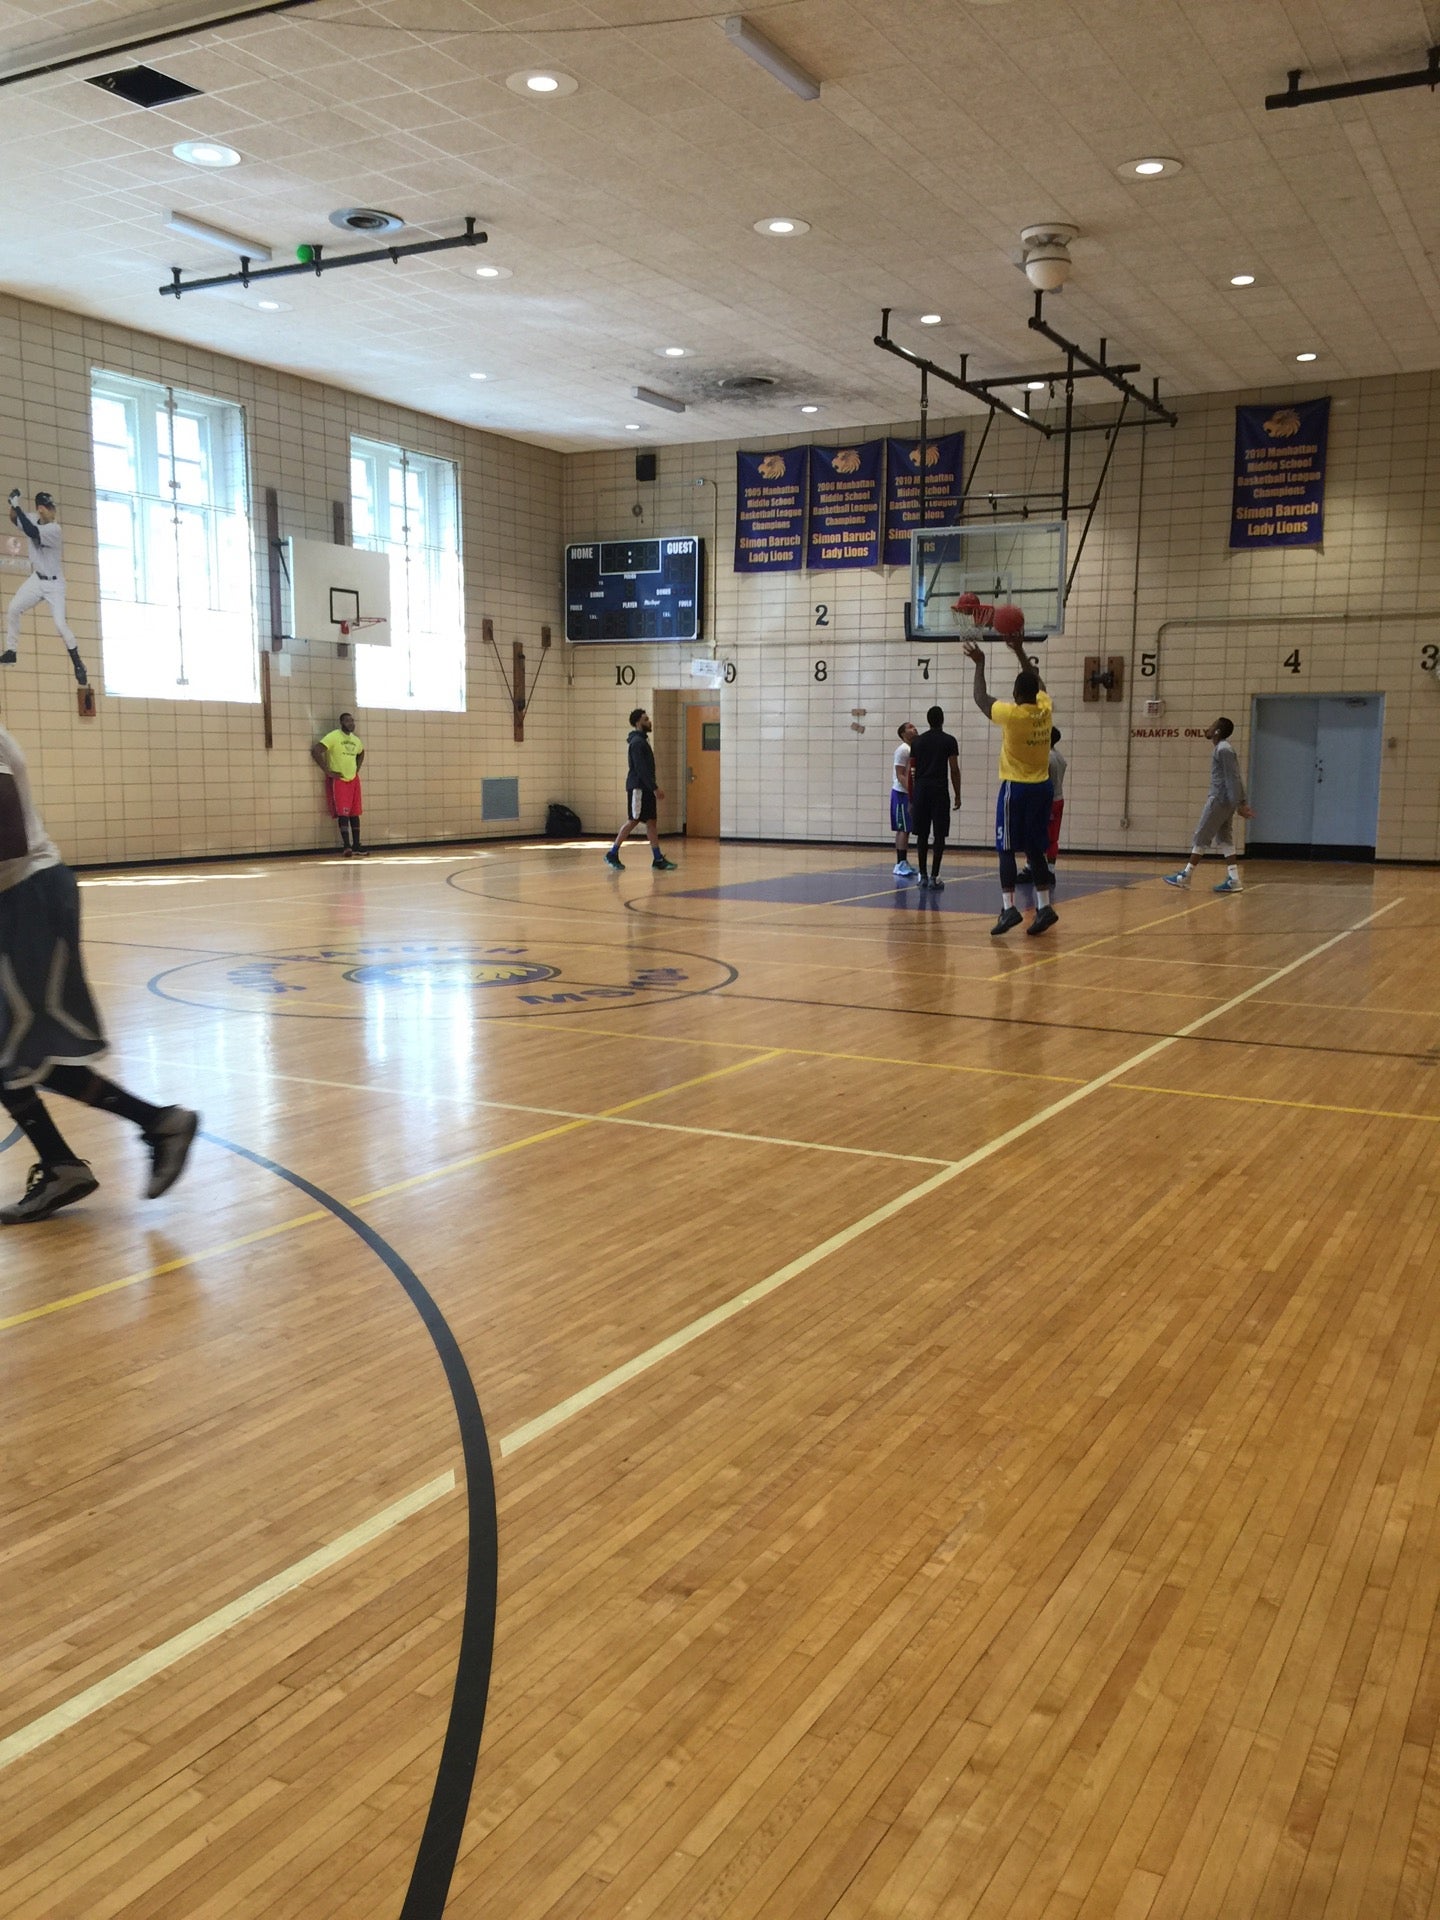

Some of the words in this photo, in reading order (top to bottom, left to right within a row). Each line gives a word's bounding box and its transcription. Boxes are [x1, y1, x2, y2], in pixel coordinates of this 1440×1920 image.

[1267, 445, 1317, 457] Manhattan
[1247, 461, 1278, 473] Middle
[1280, 457, 1312, 470] School
[836, 480, 875, 490] Manhattan
[913, 473, 955, 485] Mnhattan
[1237, 472, 1285, 487] Basketball
[1287, 471, 1321, 483] League
[763, 485, 799, 496] Manhattan
[820, 493, 843, 503] Middle
[844, 490, 870, 501] School
[1253, 485, 1306, 498] Champions
[747, 499, 770, 508] Middle
[771, 496, 795, 507] School
[812, 504, 849, 516] Basketball
[851, 502, 878, 513] League
[740, 509, 776, 520] Basketball
[777, 508, 802, 518] League
[1236, 506, 1273, 520] Simon
[1275, 501, 1319, 517] Baruch
[752, 520, 791, 531] Champions
[825, 515, 866, 526] Champions
[888, 528, 913, 540] Simo
[1247, 522, 1275, 537] Lady
[1276, 520, 1308, 534] Lions
[740, 537, 767, 549] Simon
[768, 534, 801, 548] Baruch
[812, 533, 841, 545] Simon
[842, 529, 876, 543] Baruch
[571, 548, 593, 560] HOME
[667, 541, 694, 555] GUEST
[749, 551, 769, 563] Lady
[770, 550, 794, 562] Lions
[821, 547, 842, 560] Lady
[843, 546, 869, 558] Lions
[815, 604, 829, 627] 2
[1284, 649, 1301, 674] 4
[1421, 644, 1439, 671] 3
[814, 660, 828, 682] 8
[917, 658, 931, 680] 7
[1141, 653, 1157, 677] 5
[615, 665, 636, 687] 10
[1184, 728, 1210, 738] ONLY
